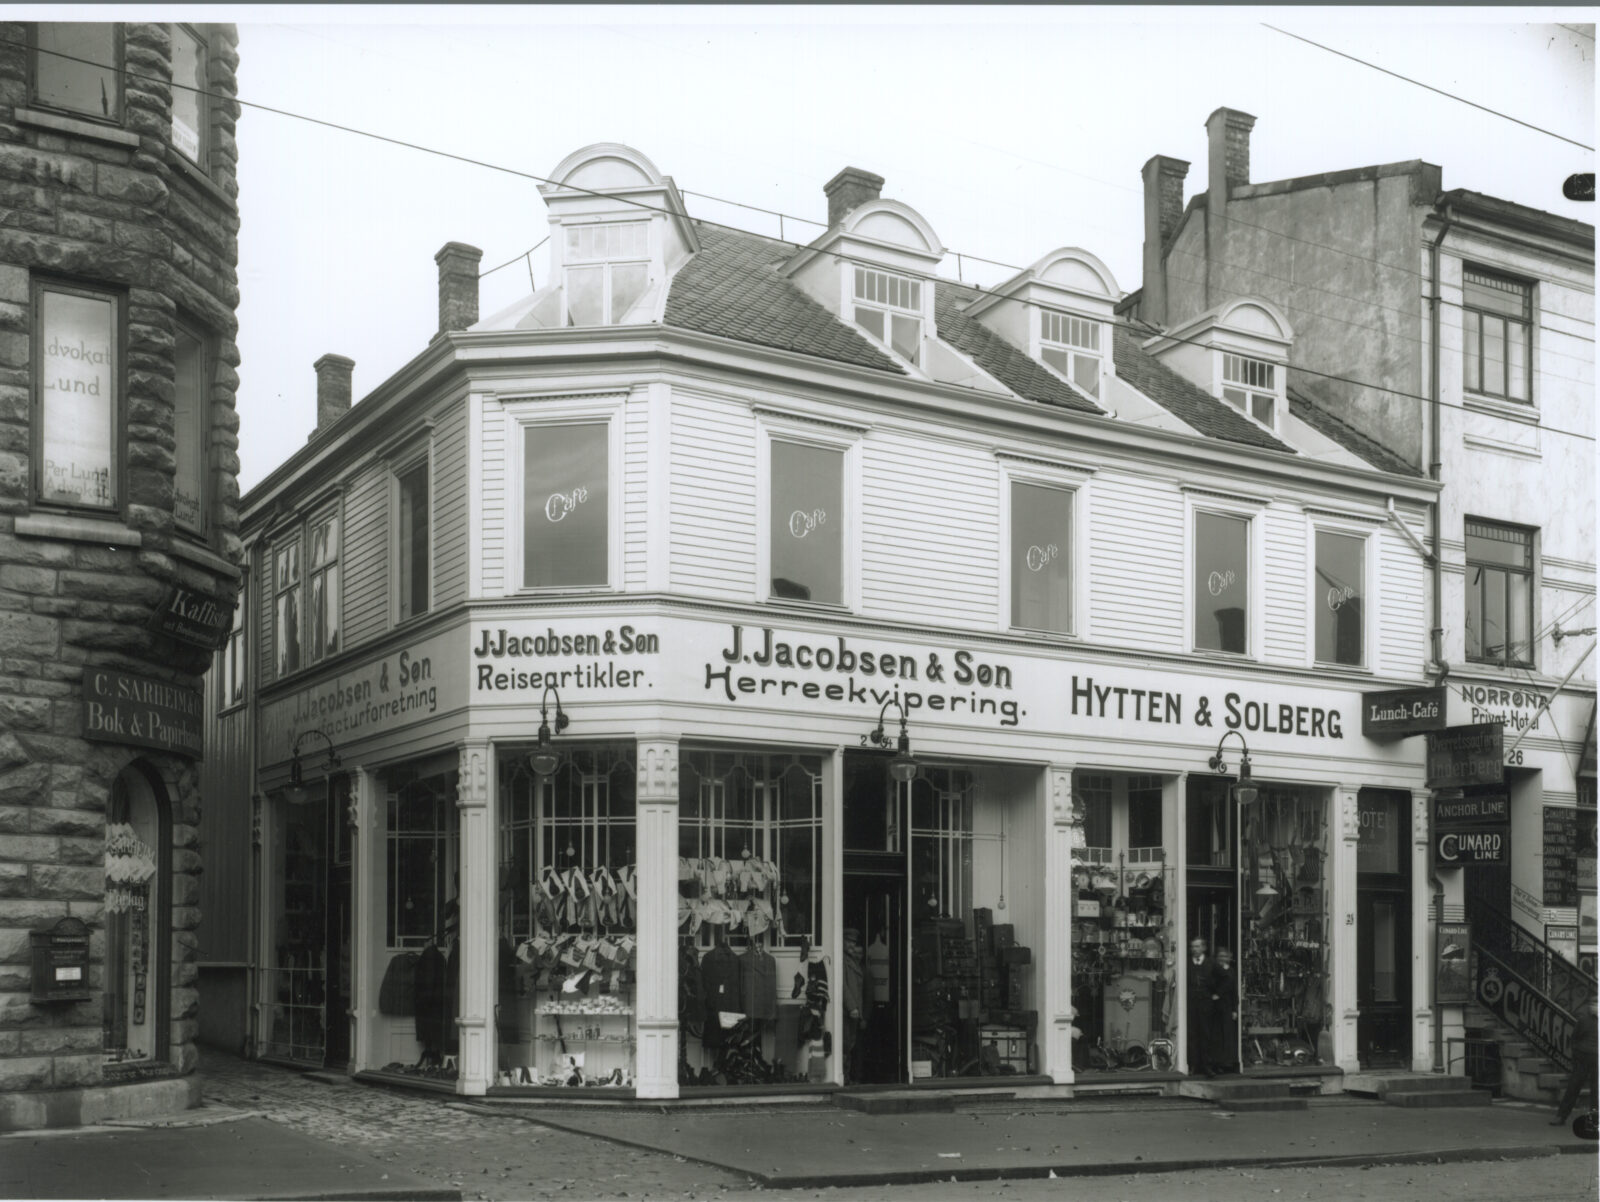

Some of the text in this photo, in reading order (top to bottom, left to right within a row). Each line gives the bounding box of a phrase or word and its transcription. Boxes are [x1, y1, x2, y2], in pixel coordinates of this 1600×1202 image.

[44, 336, 112, 366] dvokat
[45, 459, 108, 482] Per Lund
[544, 487, 588, 523] Café
[788, 508, 827, 539] Café
[1026, 544, 1058, 572] Café
[1207, 569, 1236, 597] Café
[602, 630, 618, 653] &
[618, 624, 660, 655] Søn
[379, 661, 389, 694] &
[398, 650, 432, 688] Søn
[477, 662, 653, 691] Reiseartikler.
[925, 652, 945, 682] &
[953, 650, 1013, 689] Søn
[704, 662, 1028, 726] Herreekvipering.
[1071, 675, 1343, 739] HYTTEN & SOLBERG
[87, 701, 126, 735] Bok
[130, 711, 143, 738] &
[1370, 701, 1439, 722] Lunch-Café
[1507, 750, 1524, 766] 26
[1437, 801, 1505, 817] ANCHOR LINE
[1439, 833, 1501, 861] CUNARD
[1474, 850, 1500, 860] LINE
